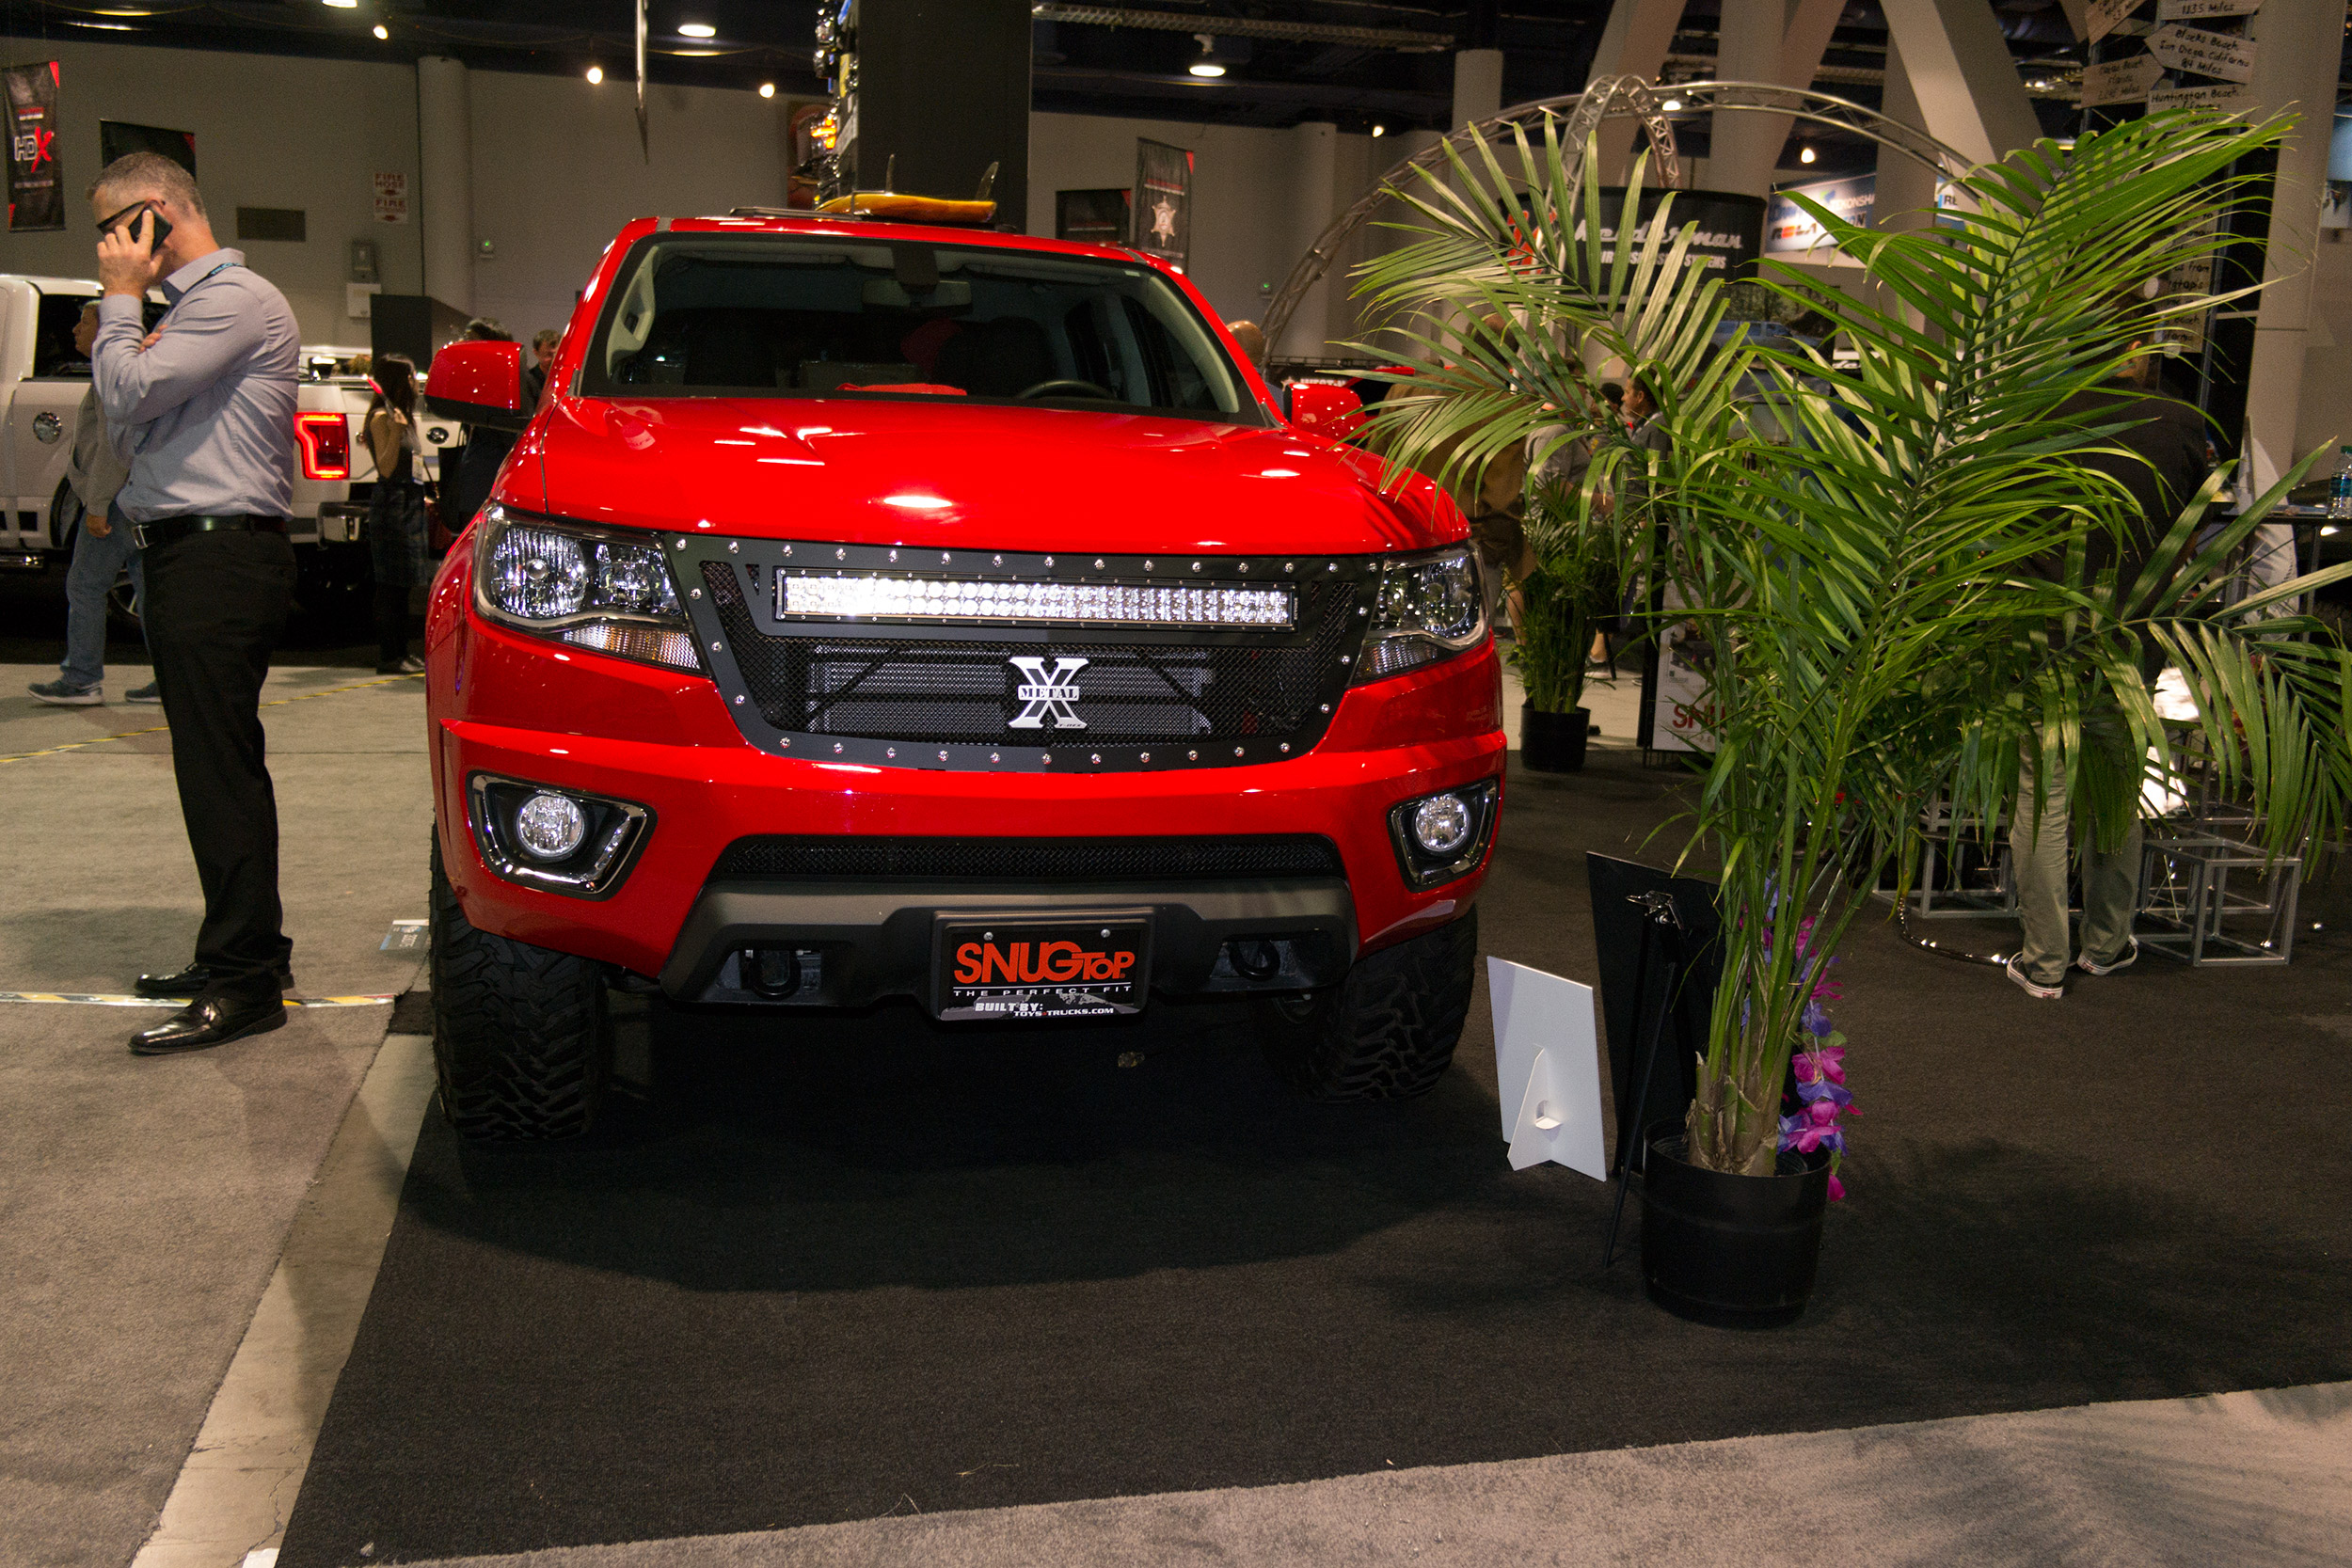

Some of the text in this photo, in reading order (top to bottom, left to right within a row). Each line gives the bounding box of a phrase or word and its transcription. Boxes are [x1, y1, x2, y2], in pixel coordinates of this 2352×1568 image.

[2151, 90, 2207, 103] Huntington
[14, 126, 55, 173] HDX
[1021, 688, 1077, 699] METAL
[1003, 988, 1090, 996] PERFECT
[1103, 985, 1132, 993] FIT
[975, 1002, 1016, 1012] BUILT
